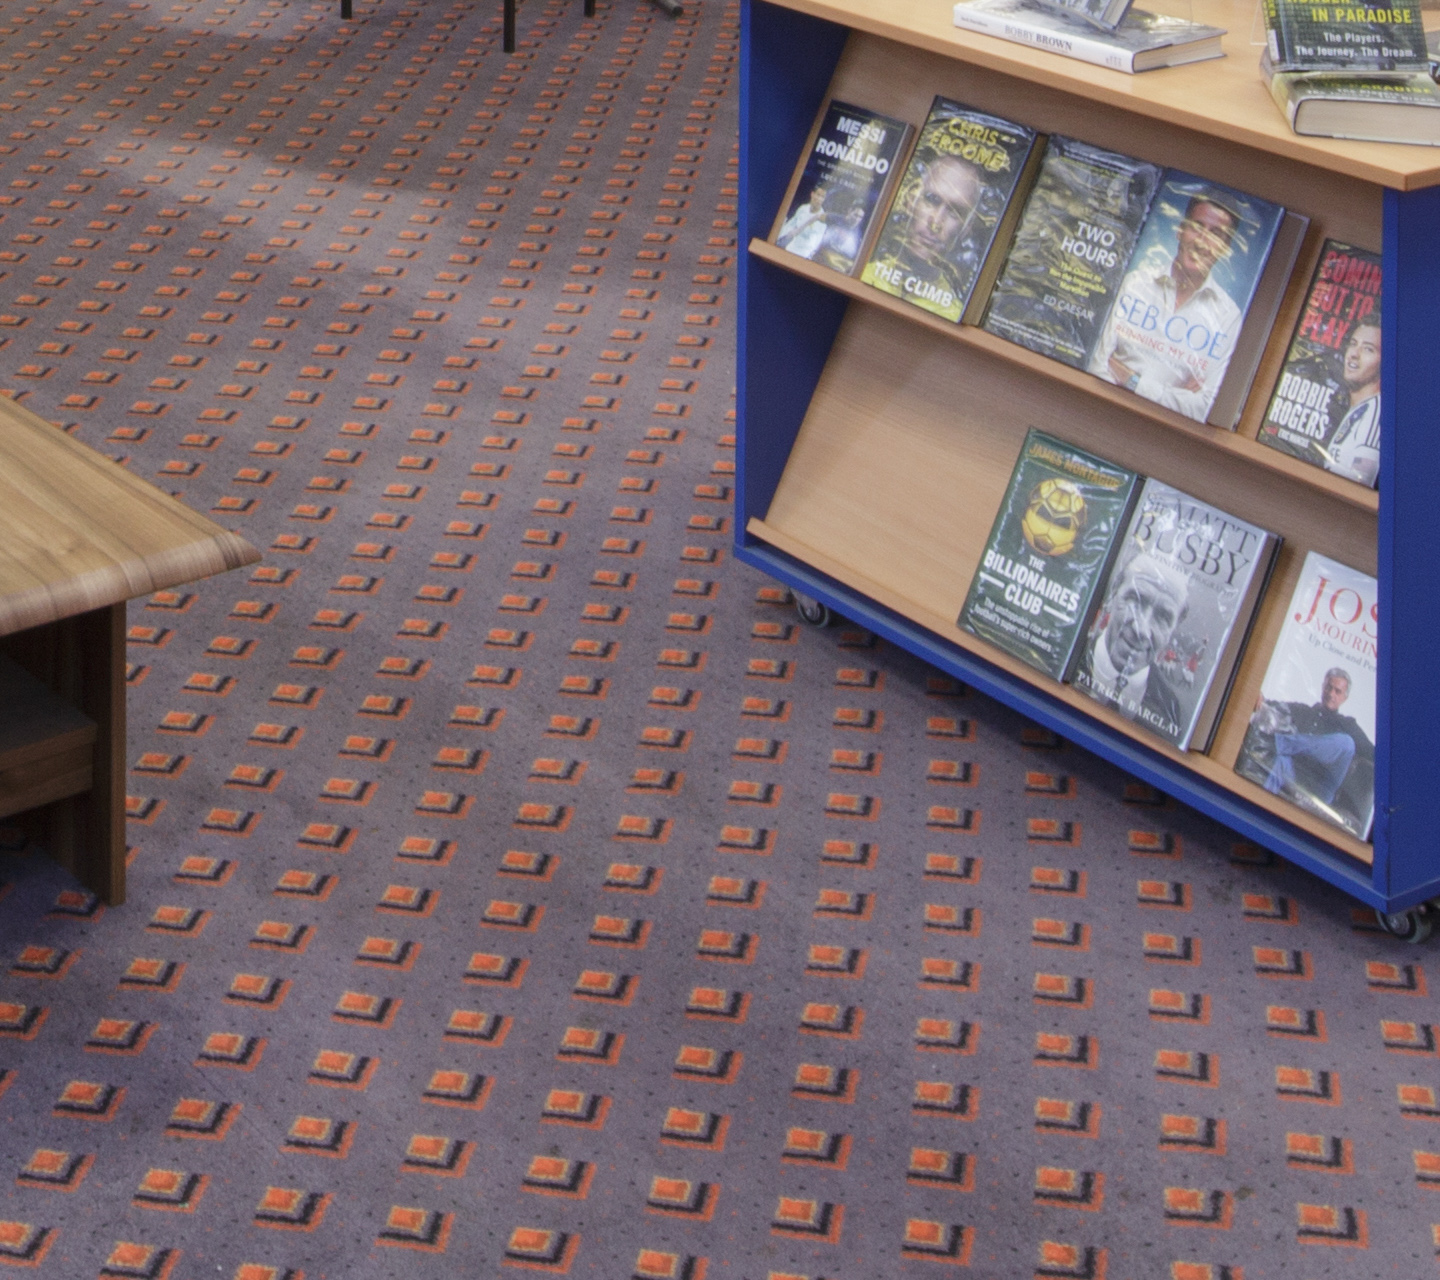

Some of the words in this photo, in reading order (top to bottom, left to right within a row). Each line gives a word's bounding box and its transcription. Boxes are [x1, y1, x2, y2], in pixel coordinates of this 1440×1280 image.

[1312, 9, 1328, 22] IN
[1336, 9, 1412, 24] PARADISE
[1004, 25, 1034, 41] BOBBY
[1036, 32, 1072, 51] BROWN
[1295, 45, 1313, 56] The
[1317, 46, 1358, 58] Journey.
[1361, 46, 1379, 57] The
[1382, 46, 1417, 57] Dream.
[1324, 32, 1342, 42] The
[1345, 32, 1385, 44] Players.
[836, 116, 887, 145] MESSI
[846, 136, 863, 151] VS.
[948, 117, 1000, 146] CHRIS
[815, 138, 889, 174] RONALDO
[930, 131, 1005, 172] FROOME
[1061, 236, 1118, 268] HOURS
[1077, 221, 1115, 247] TWO
[874, 262, 902, 286] THE
[904, 276, 954, 308] CLIMB
[1323, 250, 1382, 295] COMIN
[1043, 294, 1056, 306] ED
[1057, 298, 1096, 321] CAESAR
[1311, 279, 1349, 318] OUT
[1350, 291, 1375, 321] TO
[1114, 295, 1160, 332] SEB
[1164, 316, 1228, 360] COE
[1115, 324, 1164, 353] RUNNING
[1168, 345, 1185, 360] MY
[1186, 351, 1209, 371] LIFE
[1299, 310, 1350, 350] PLAY
[1278, 372, 1335, 413] ROBBIE
[1269, 396, 1330, 440] ROGERS
[1028, 442, 1064, 468] JAMES
[1063, 458, 1122, 489] MONTAGUE
[1166, 497, 1257, 555] MATT
[1028, 554, 1046, 572] THE
[1133, 511, 1250, 587] BUSBY
[984, 549, 1080, 613] BILLIONAIRES
[1004, 583, 1044, 616] CLUB
[1294, 576, 1378, 640] JOS
[1309, 632, 1321, 648] Up
[1321, 639, 1345, 658] Close
[1345, 652, 1362, 667] and
[1313, 614, 1378, 659] MOURIN
[1076, 671, 1126, 705] PATRICK
[1128, 697, 1182, 739] BARCLAY
